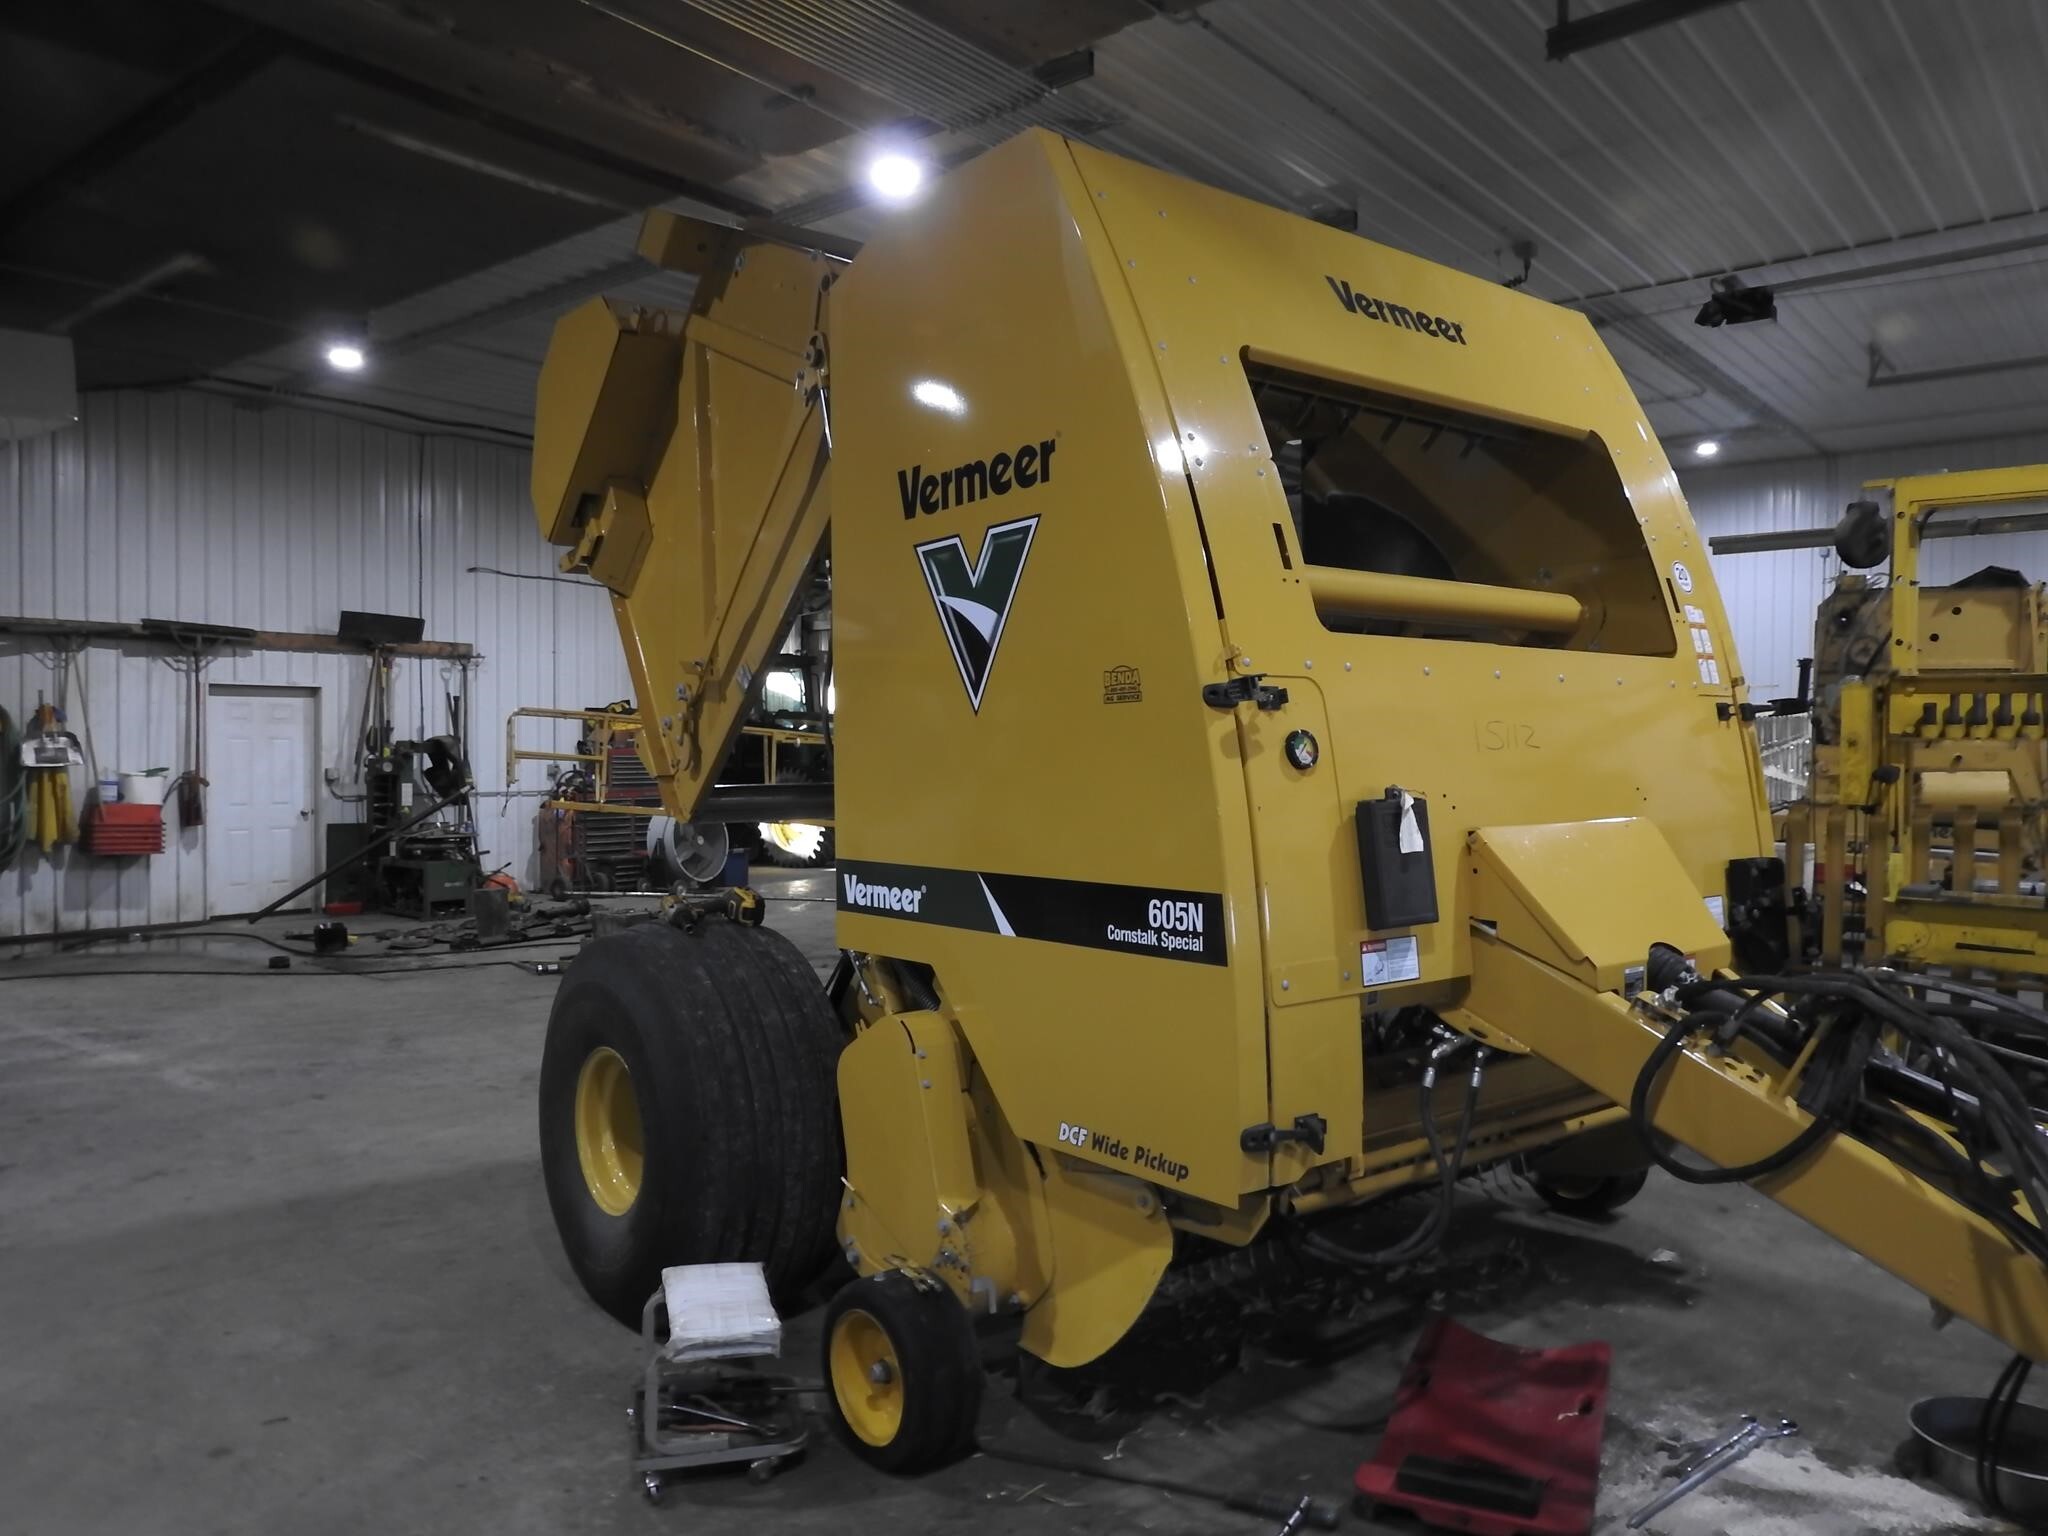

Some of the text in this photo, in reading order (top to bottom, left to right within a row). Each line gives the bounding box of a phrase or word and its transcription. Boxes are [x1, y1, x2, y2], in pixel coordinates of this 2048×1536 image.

[1325, 275, 1467, 345] Vermeer
[898, 438, 1056, 520] Vermeer
[843, 873, 922, 913] Vermeer
[1148, 899, 1203, 932] 605N
[1107, 924, 1203, 952] Cornstalk Special
[1058, 1121, 1189, 1182] DCF Wide Pickup
